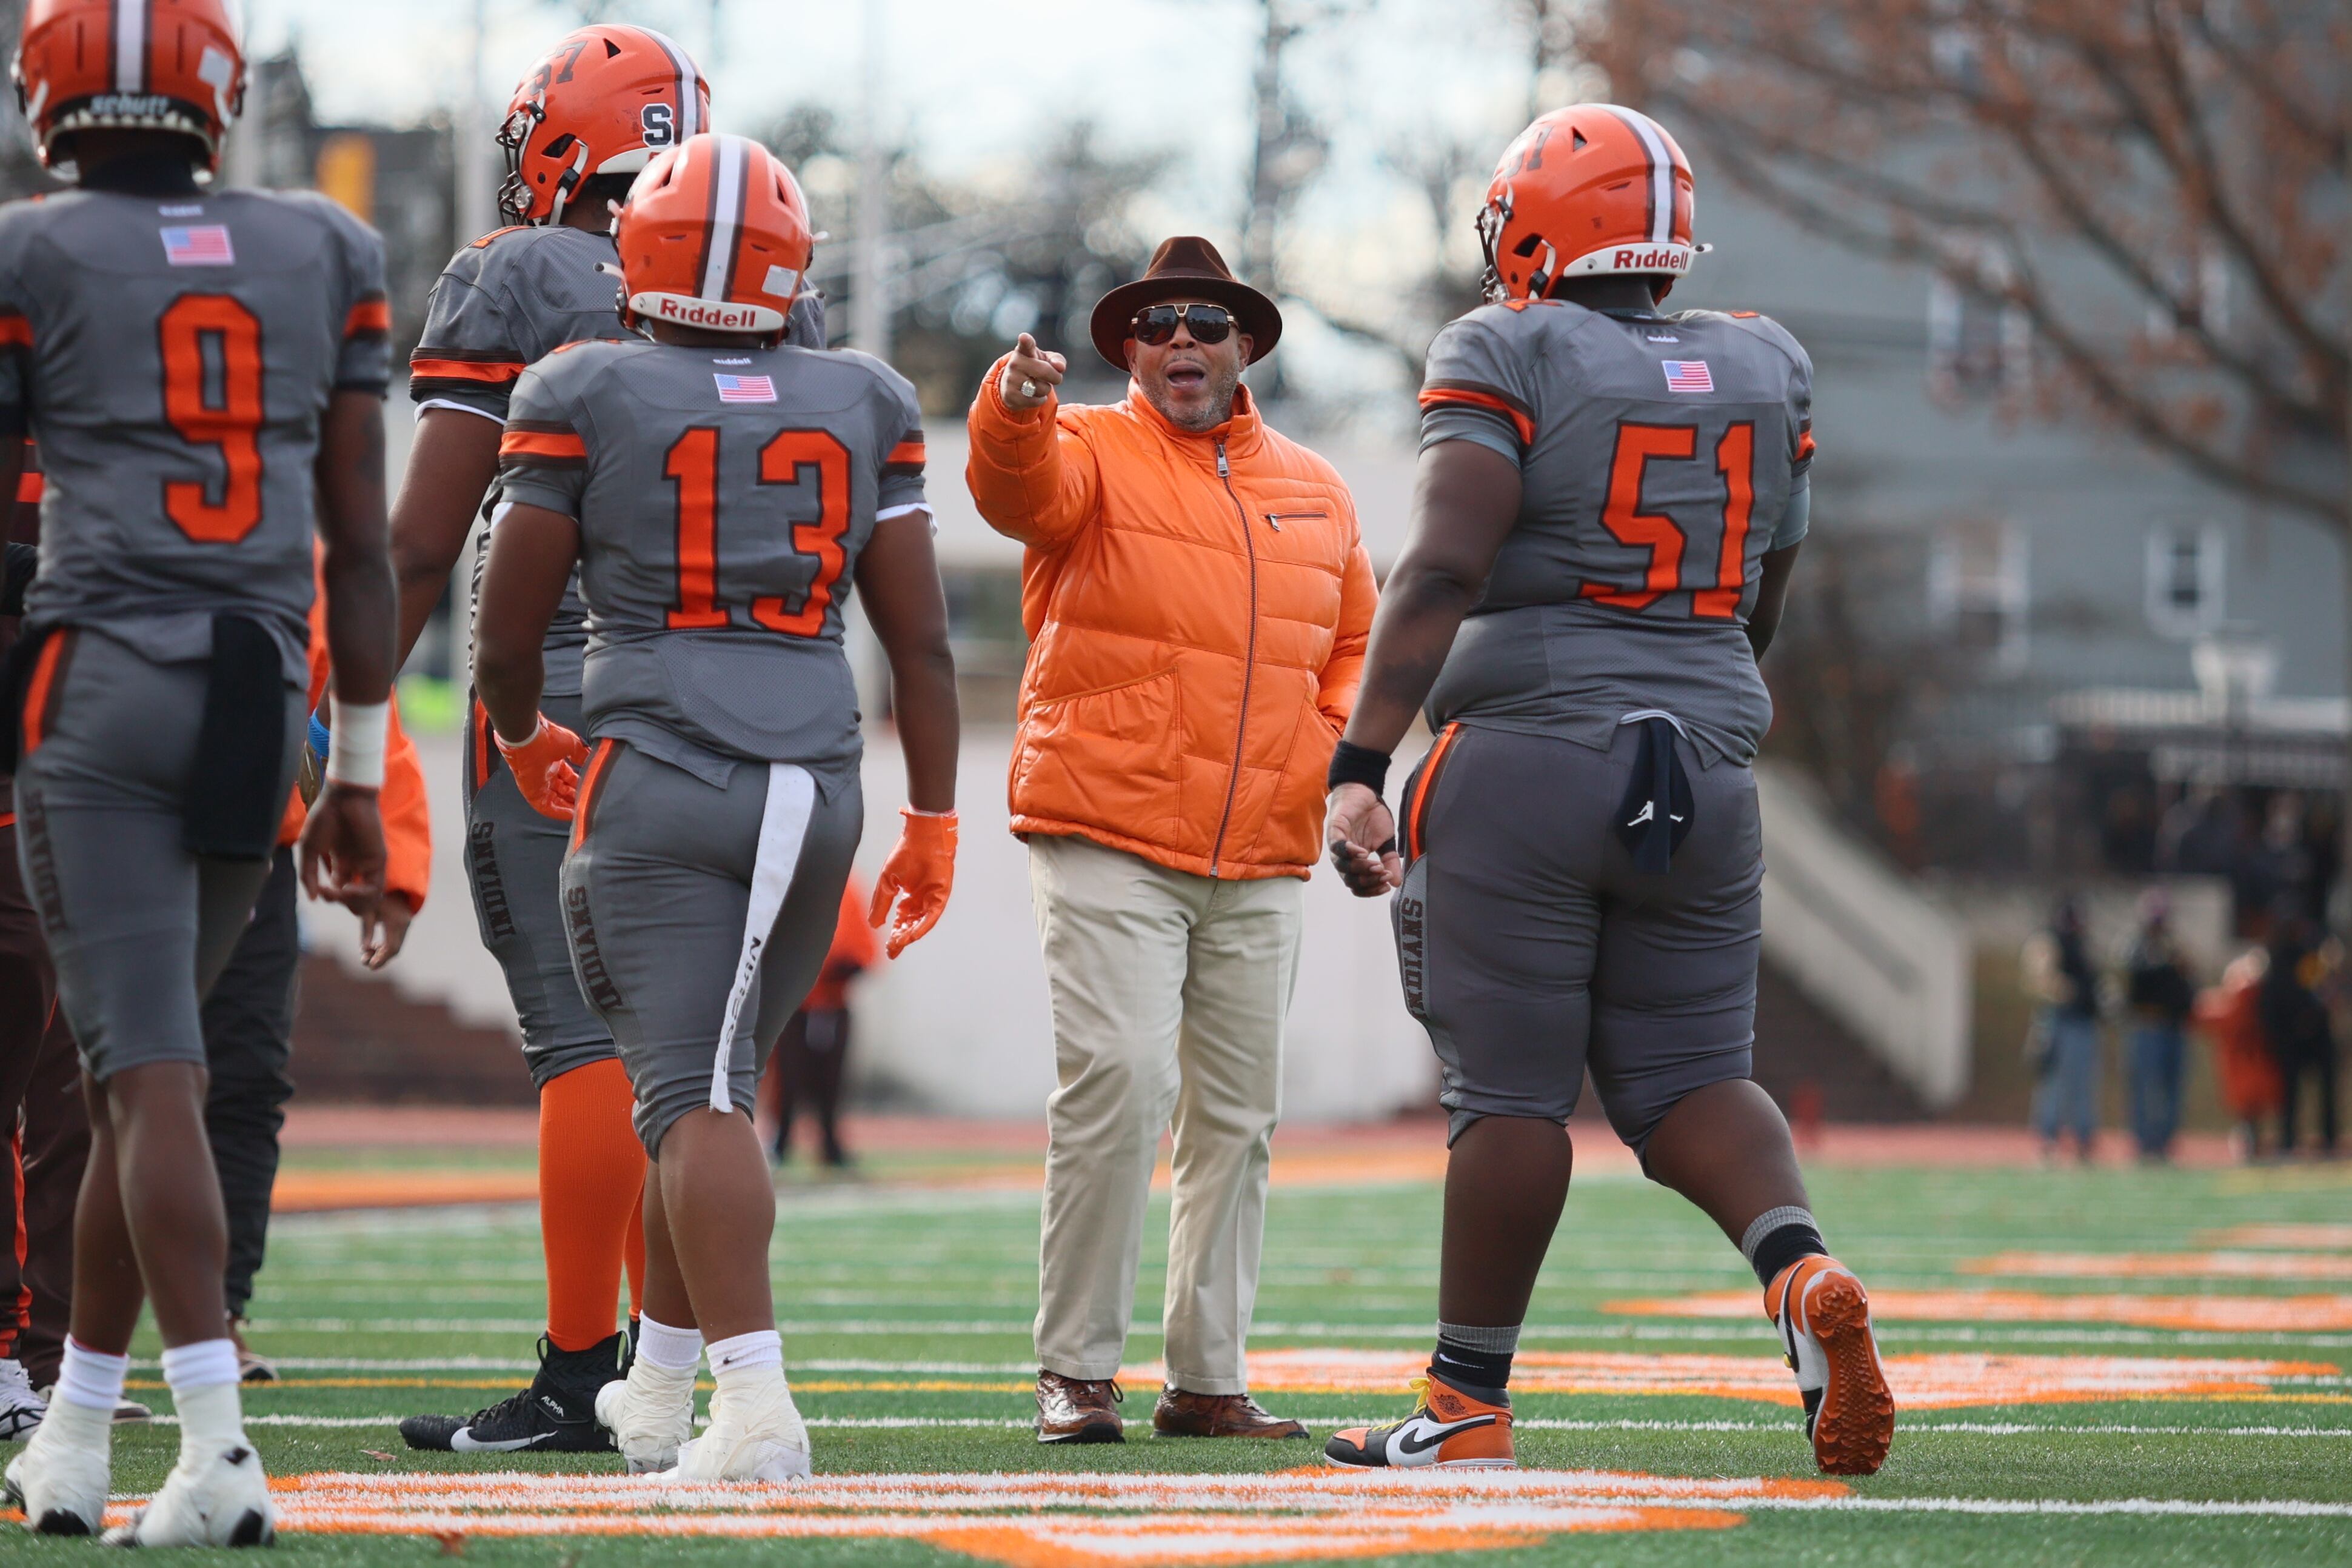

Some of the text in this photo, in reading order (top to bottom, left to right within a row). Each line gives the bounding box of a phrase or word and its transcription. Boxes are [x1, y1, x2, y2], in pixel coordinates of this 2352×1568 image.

[640, 102, 675, 147] S
[660, 298, 757, 328] Riddell
[1613, 249, 1689, 271] Riddell
[157, 292, 264, 544] 9
[661, 425, 852, 638] 13
[1577, 419, 1756, 622] 51
[471, 821, 516, 939] INDIANS
[567, 886, 623, 1012] INDIANS
[1401, 896, 1428, 1020] INDIANS
[540, 1395, 564, 1418] ALPHA
